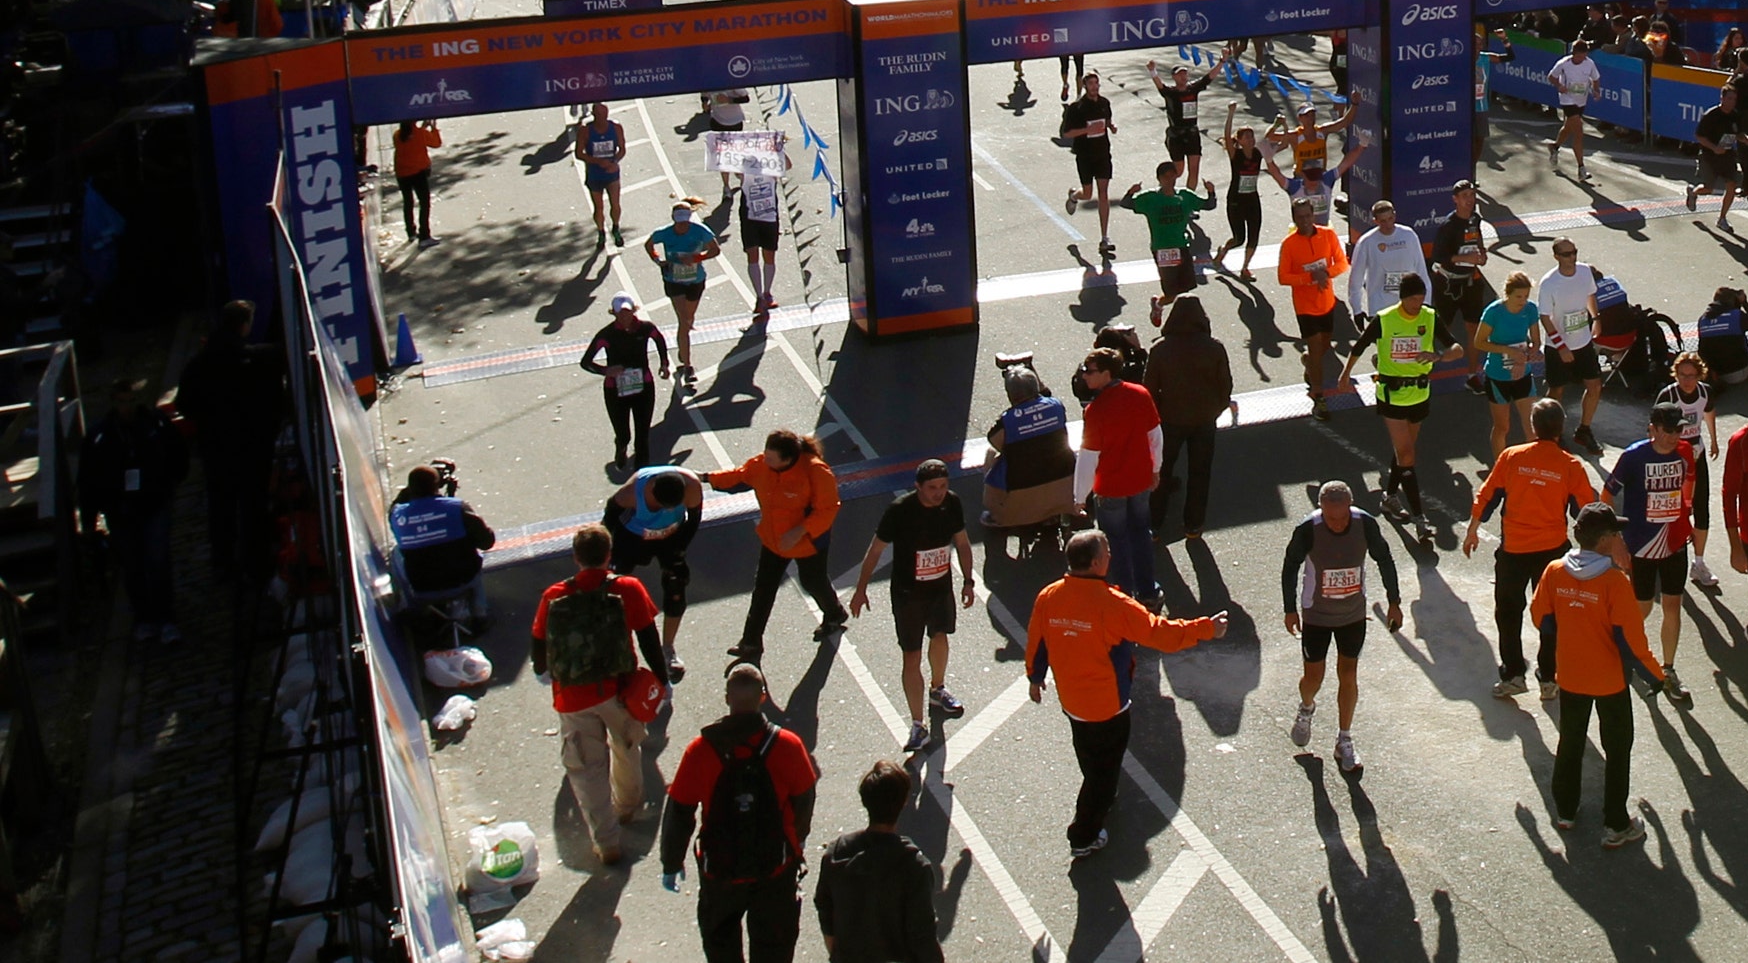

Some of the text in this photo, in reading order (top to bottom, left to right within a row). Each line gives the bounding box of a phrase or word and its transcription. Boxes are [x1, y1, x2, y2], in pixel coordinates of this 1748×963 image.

[1300, 6, 1331, 19] Locker
[371, 8, 828, 62] THE ING NEW YORK CITY MARATHON
[1109, 18, 1167, 44] ING
[991, 32, 1051, 47] UNITED
[878, 51, 947, 67] THE RUDIN
[1398, 43, 1437, 61] ING
[614, 69, 632, 77] NEW
[633, 67, 654, 76] YORK
[888, 62, 933, 75] FAMILY
[1505, 63, 1525, 79] Foot
[545, 77, 580, 93] ING
[614, 72, 675, 85] MARATHON
[875, 94, 920, 115] ING
[1404, 104, 1445, 115] UNITED
[886, 162, 934, 174] UNITED
[1419, 155, 1431, 170] 4
[922, 189, 951, 201] Locker
[906, 218, 919, 234] 4
[891, 256, 905, 264] THE
[906, 253, 928, 262] RUDIN
[1645, 476, 1682, 491] FRANCE
[1652, 499, 1678, 510] 12-456
[1327, 576, 1356, 588] 12-813
